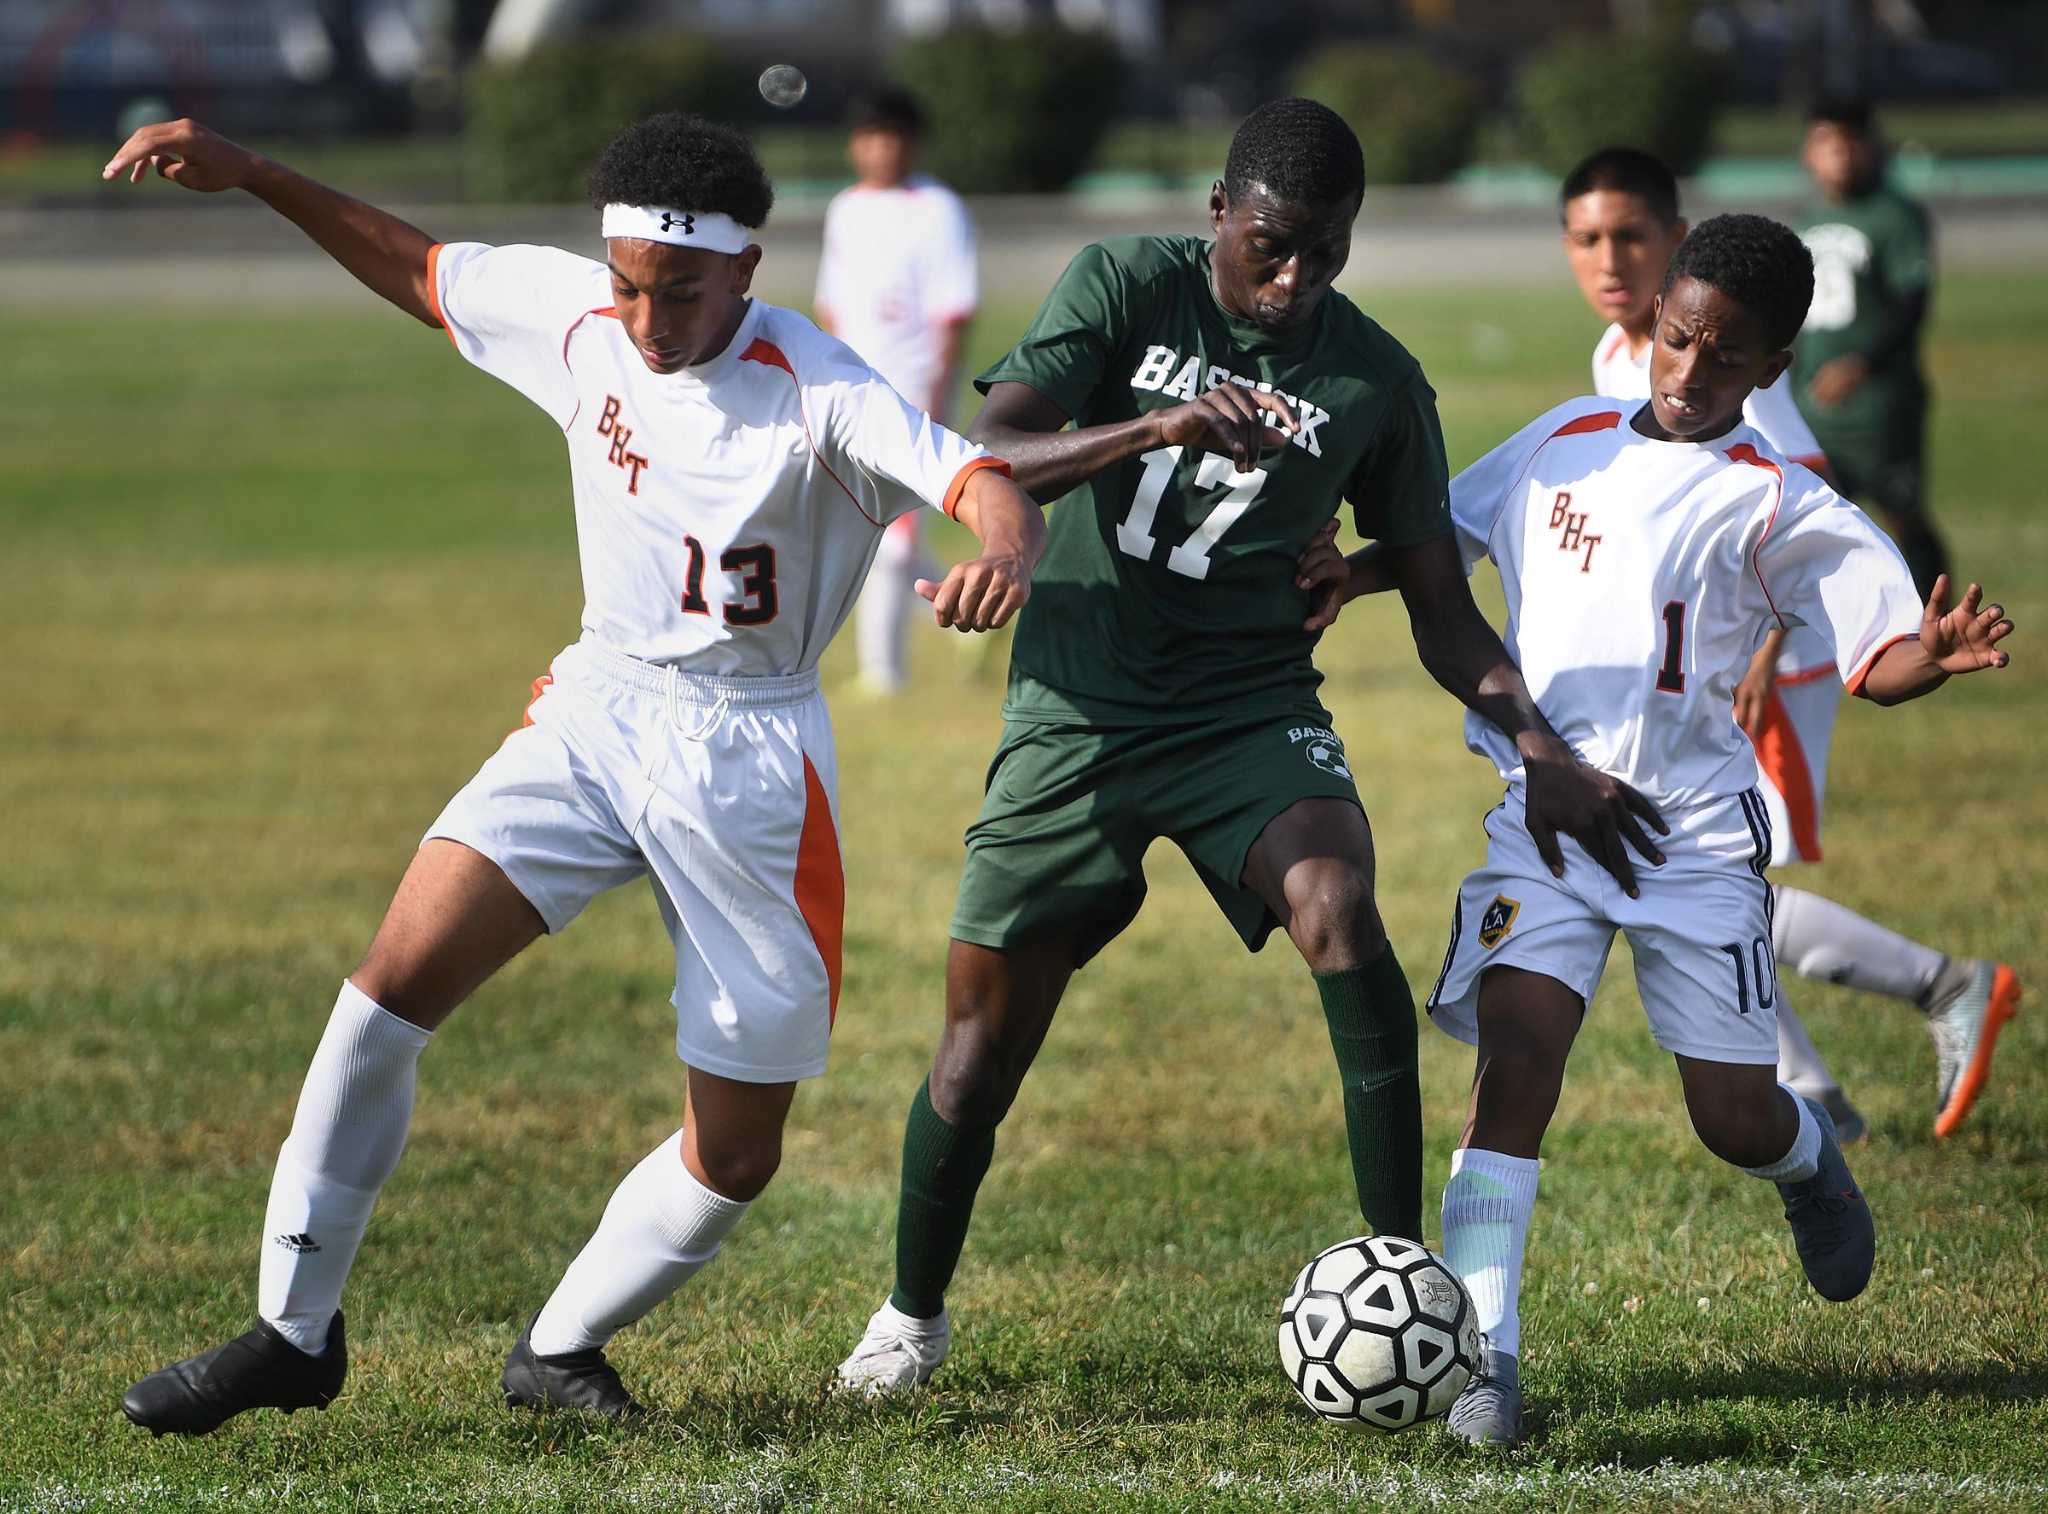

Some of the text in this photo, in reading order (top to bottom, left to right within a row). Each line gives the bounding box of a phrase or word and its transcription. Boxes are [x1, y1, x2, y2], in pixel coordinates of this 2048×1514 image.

[597, 394, 648, 496] BHT
[1116, 445, 1268, 580] 17
[1549, 490, 1602, 574] BHT
[681, 533, 779, 626] 13
[1655, 599, 1686, 694] 1
[1484, 912, 1504, 930] LA
[1719, 934, 1774, 1014] 10
